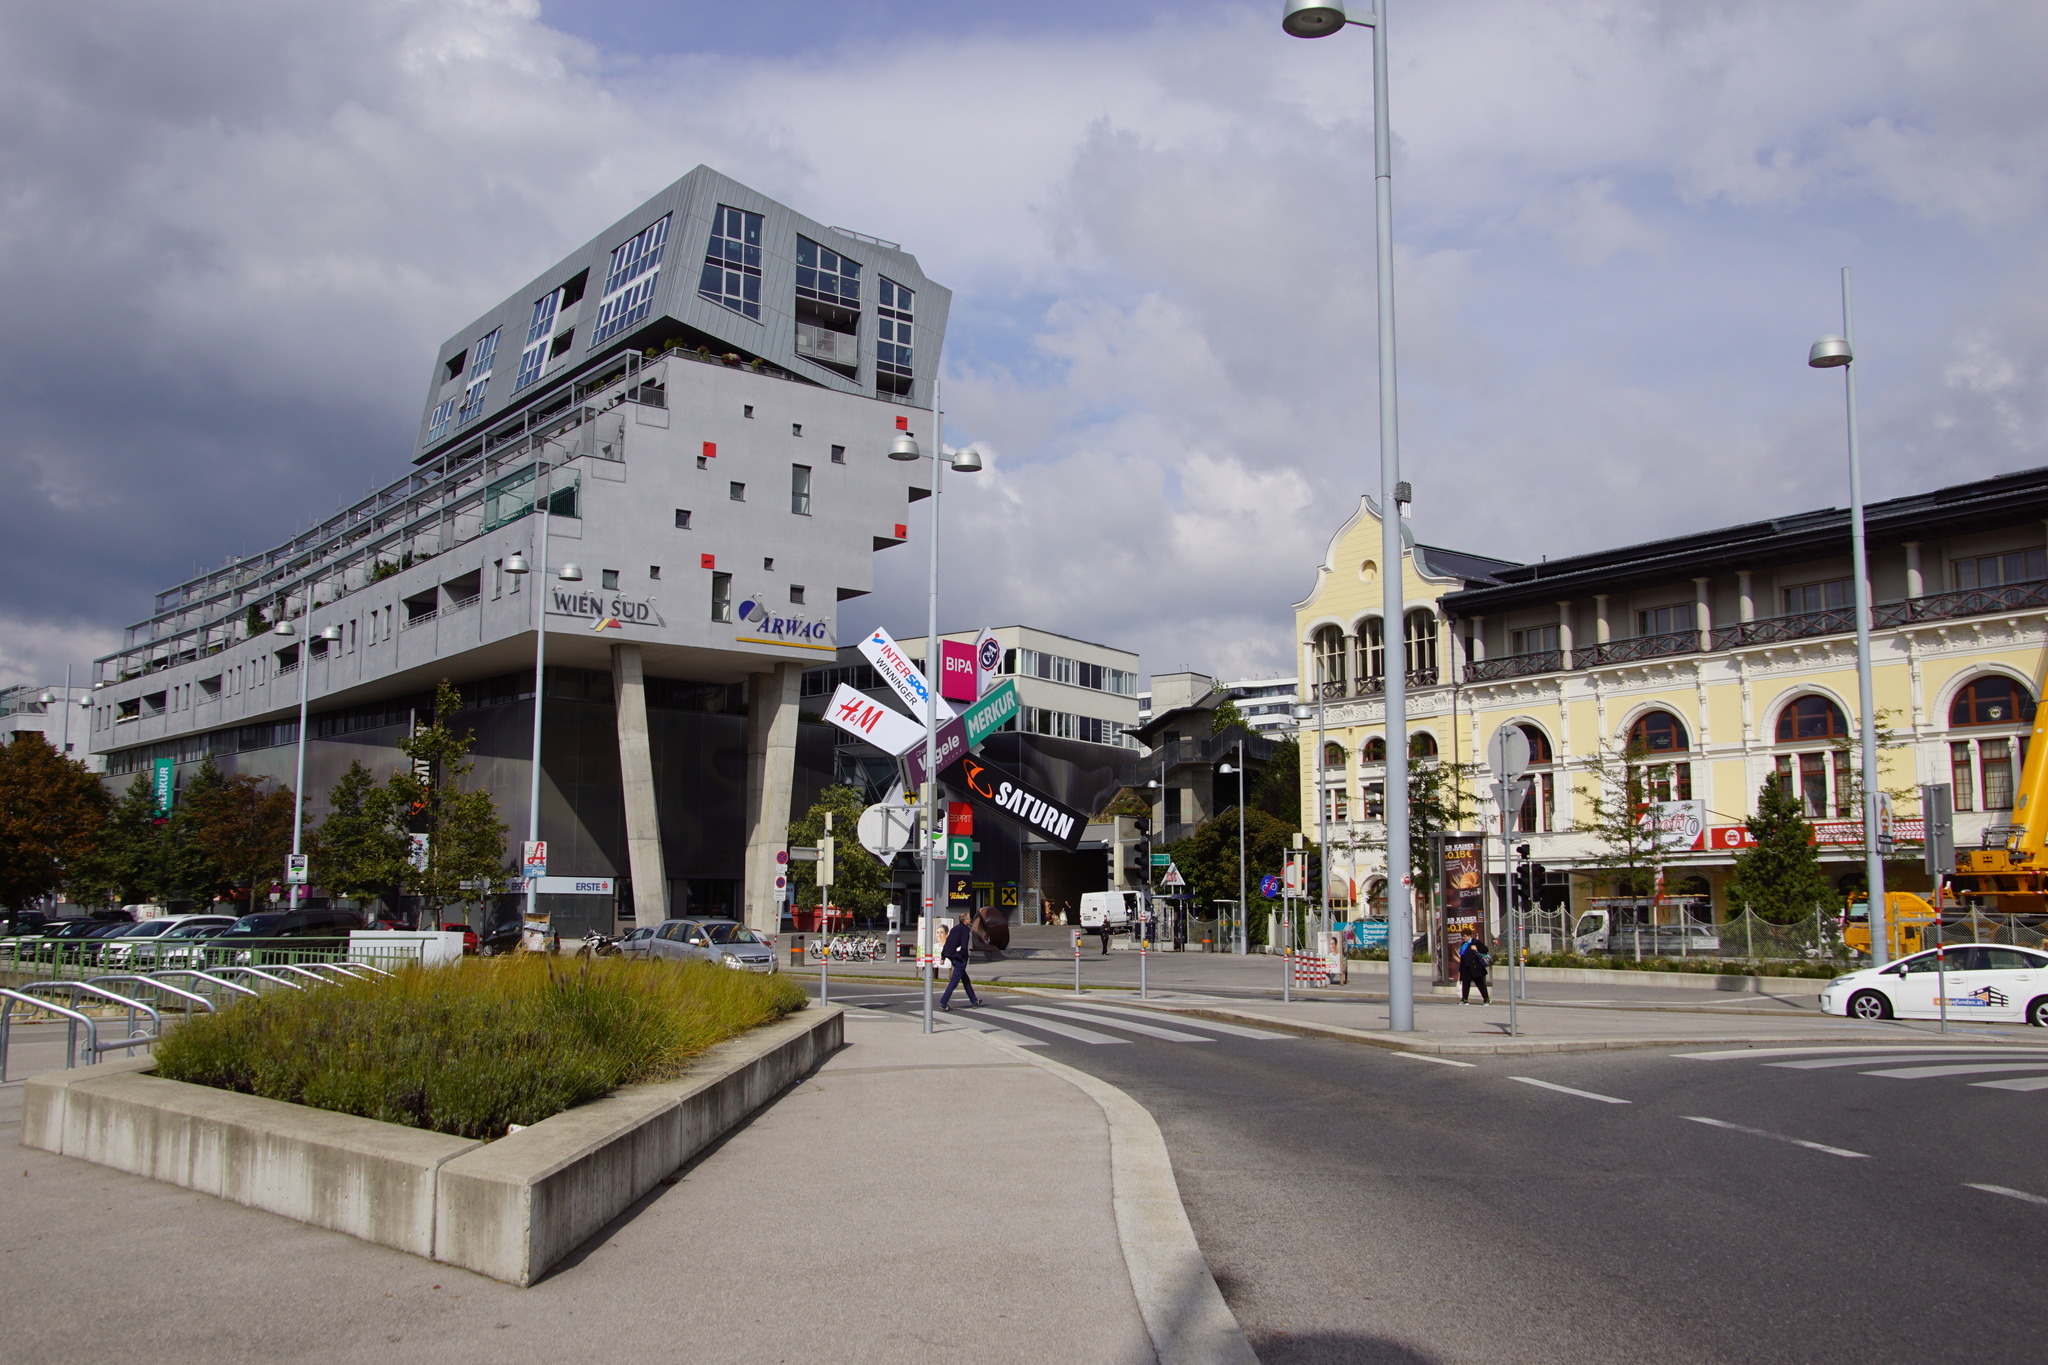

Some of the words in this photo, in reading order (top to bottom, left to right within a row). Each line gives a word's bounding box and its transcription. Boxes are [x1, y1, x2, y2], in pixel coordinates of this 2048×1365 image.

[553, 592, 603, 616] WIEN
[611, 598, 650, 621] SÜD
[756, 616, 827, 640] ARWAG
[945, 656, 973, 675] BIPA
[982, 644, 998, 666] C&A
[876, 656, 918, 706] WINNINGER
[881, 644, 930, 704] INTERSPOR
[835, 696, 884, 735] H&M
[968, 690, 1016, 739] MERKUR
[918, 735, 960, 772] Vgele
[949, 814, 972, 823] ESPRIT
[995, 781, 1075, 840] SATURN
[576, 882, 600, 891] ERSTE
